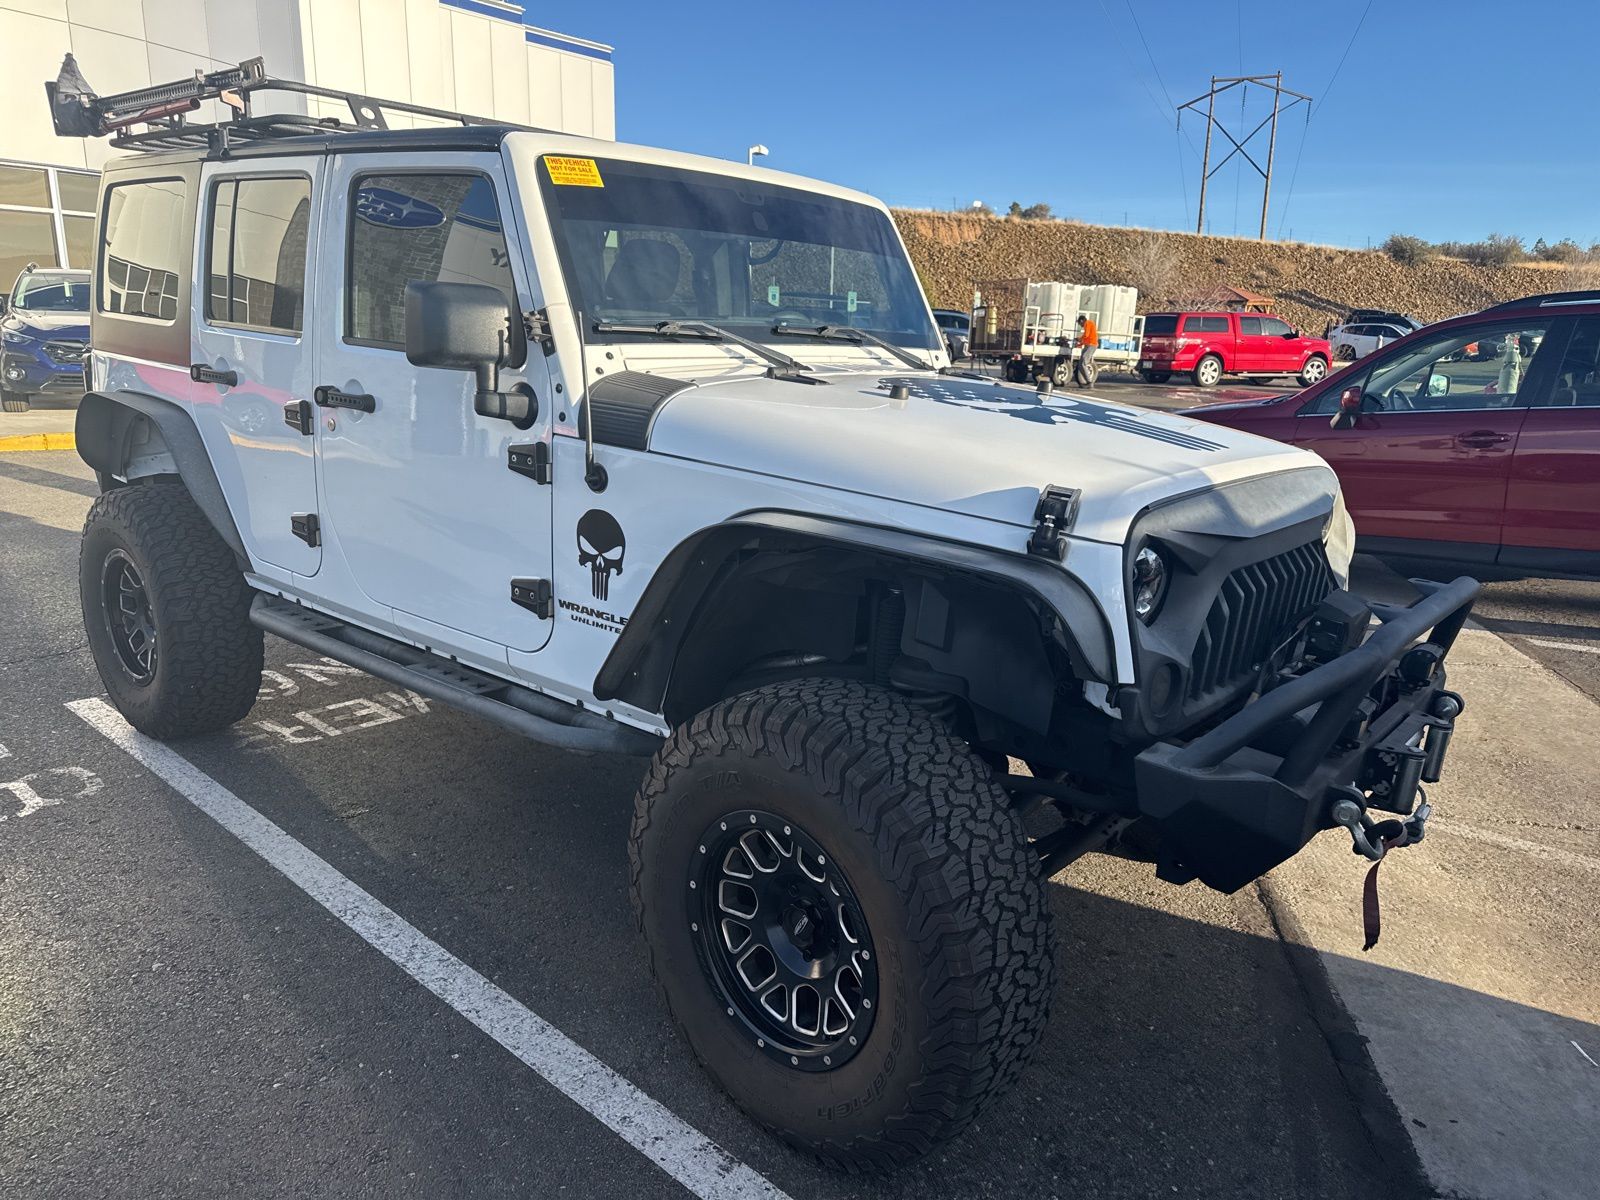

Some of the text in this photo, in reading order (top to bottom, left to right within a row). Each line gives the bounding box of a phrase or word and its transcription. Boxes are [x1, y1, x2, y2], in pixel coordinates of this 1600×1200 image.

[563, 159, 592, 167] VEHICLE
[558, 599, 629, 626] WRANGLE
[570, 614, 622, 634] UNLIMITE
